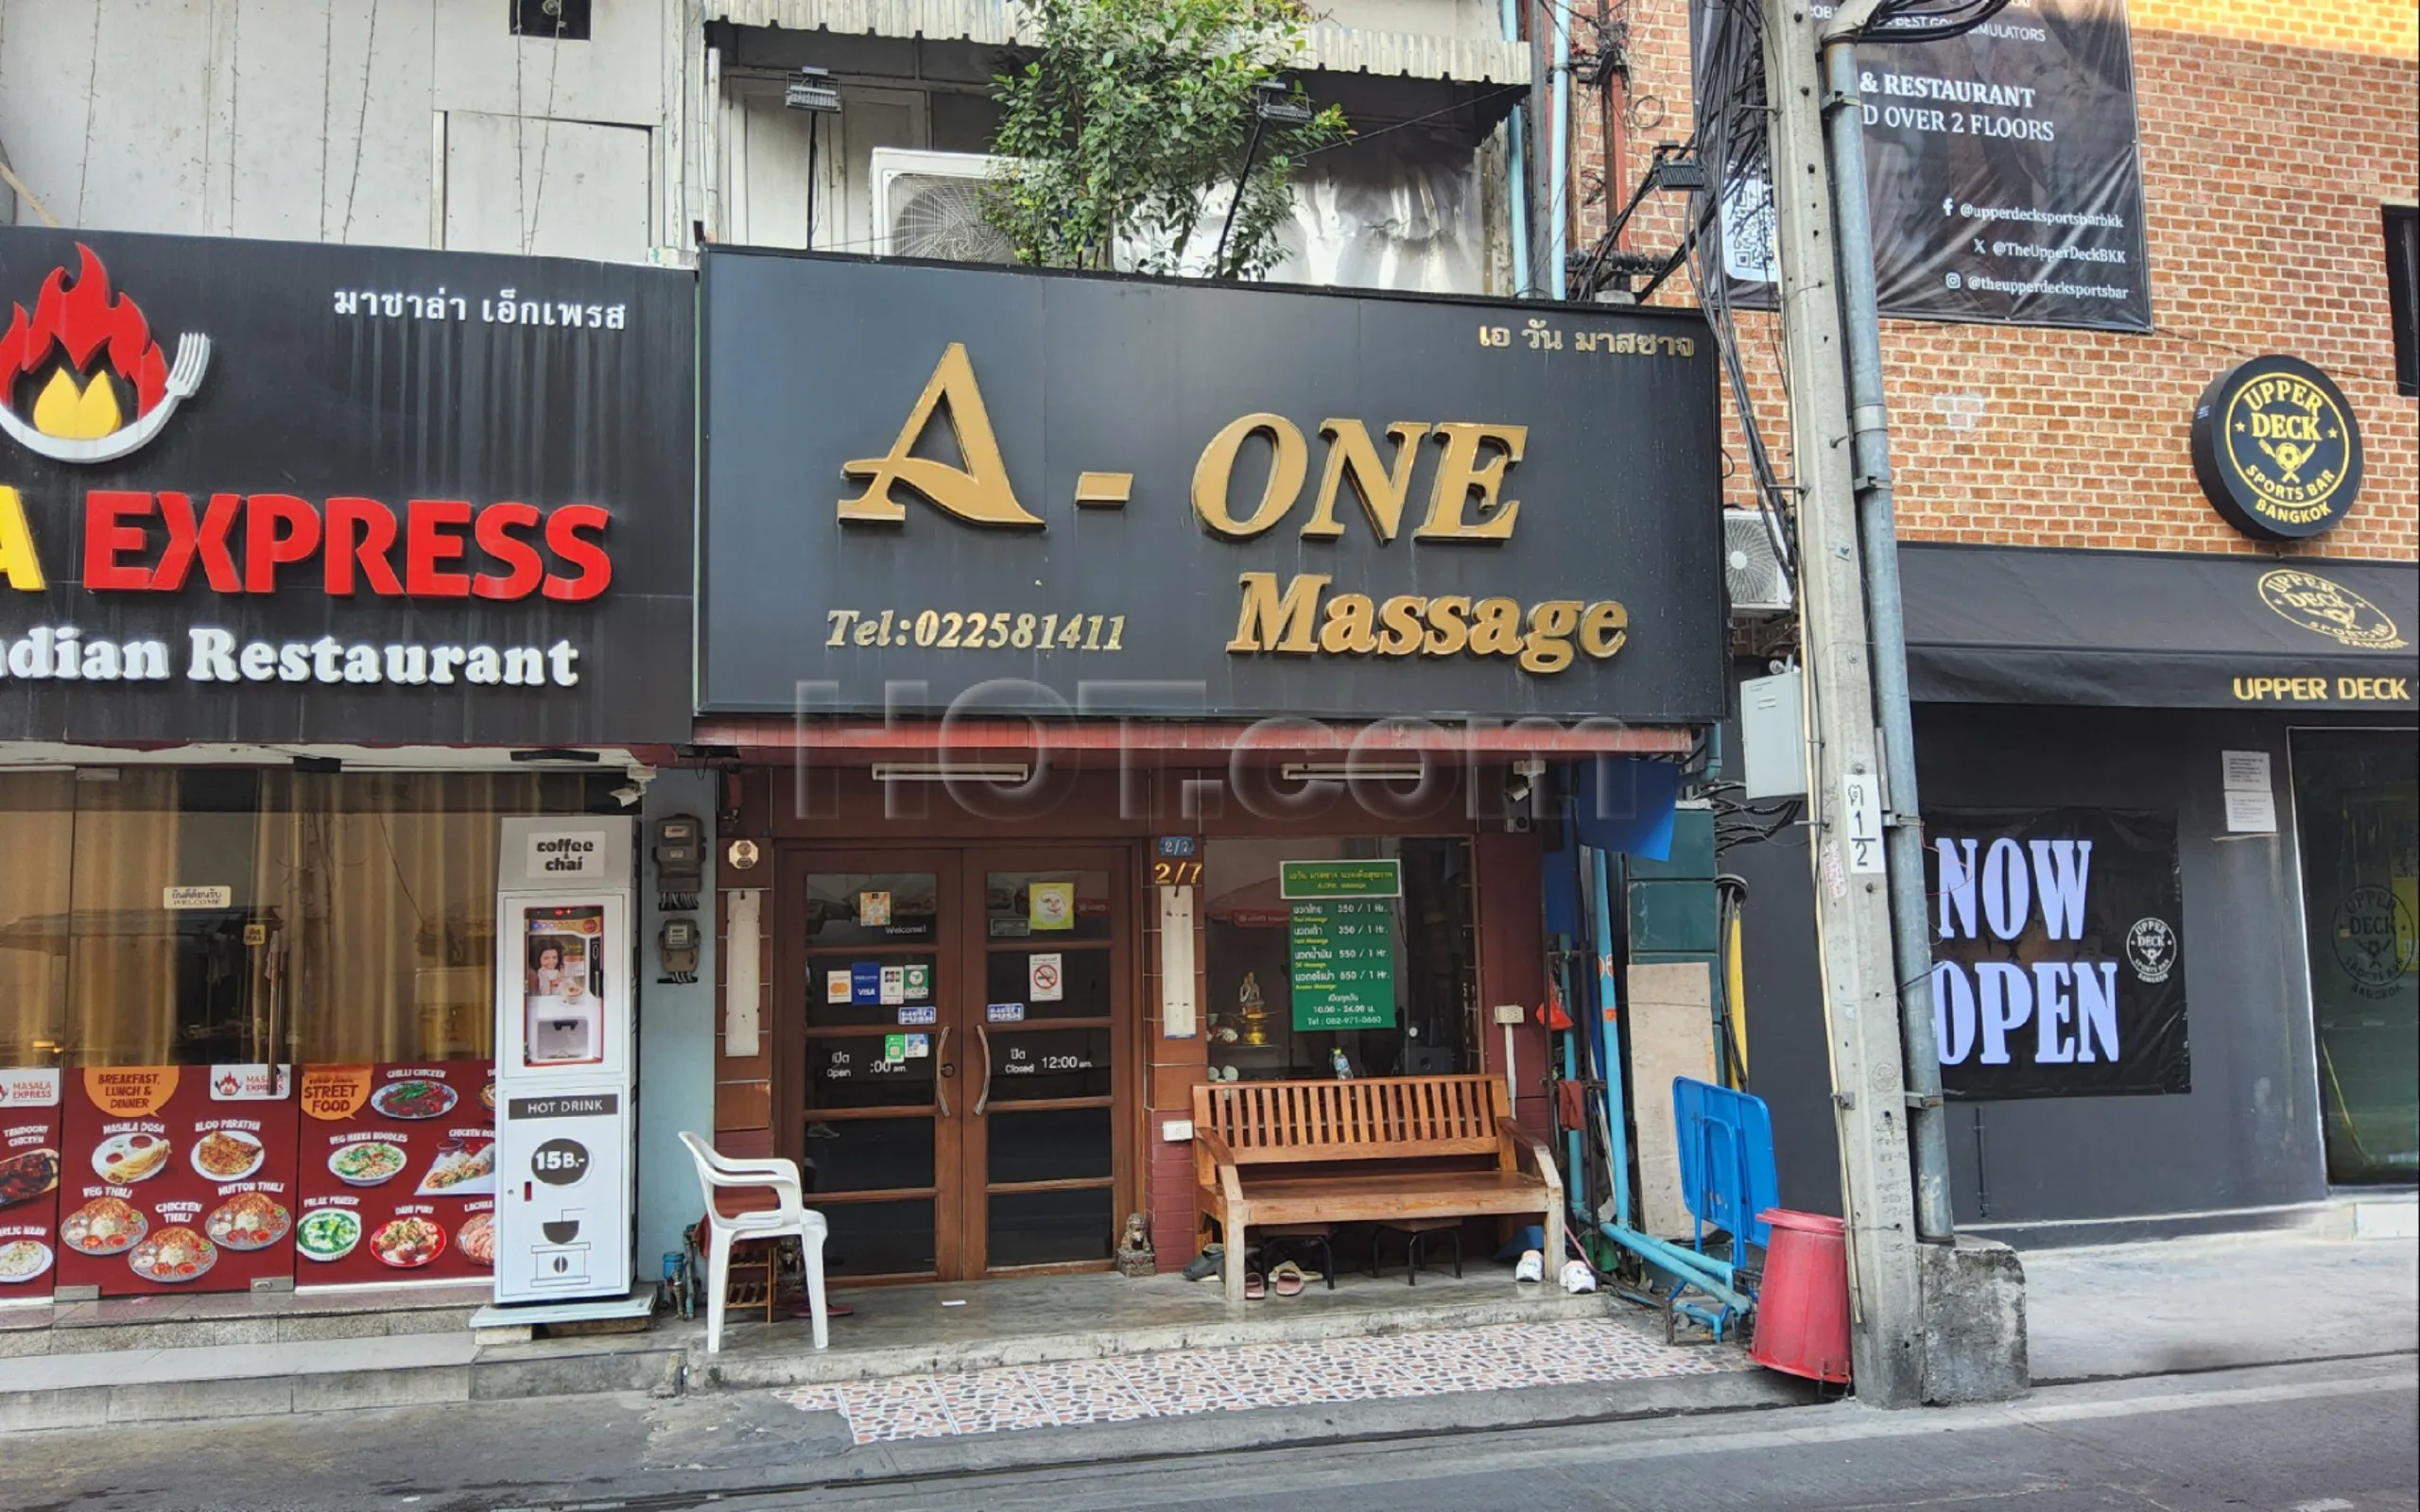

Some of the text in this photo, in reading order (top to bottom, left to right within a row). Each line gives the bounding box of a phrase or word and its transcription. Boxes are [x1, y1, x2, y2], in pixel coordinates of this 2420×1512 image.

[1859, 72, 2035, 108] & RESTAURANT
[1862, 105, 2054, 141] D OVER 2 FLOORS
[1961, 203, 2124, 228] @upperdecksportsbarbkk
[1993, 241, 2126, 264] @TheUpperDeckBKK
[1968, 275, 2129, 300] @theupperdecksportsbar
[482, 289, 626, 330] เอ็กเพรส
[1479, 318, 1695, 357] เอ วัน มาสซาจ
[2243, 380, 2323, 417] UPPER
[2251, 412, 2323, 441] DECK
[837, 341, 1046, 527] A
[1191, 412, 1529, 544] ONE
[2246, 464, 2335, 500] SPORTS BAR
[2256, 499, 2332, 524] BANGKOK
[83, 490, 612, 602] EXPRESS
[2265, 573, 2339, 597] UPPER
[2282, 592, 2355, 610] DECK
[826, 610, 1126, 650] Tel:022581411
[1225, 571, 1629, 675] Massage
[188, 629, 579, 686] Restaurant
[2233, 677, 2411, 701] UPPER DECK
[1855, 810, 1862, 835] 1
[537, 838, 594, 851] coffee
[1856, 840, 1868, 866] 2
[545, 856, 583, 871] chai
[1154, 861, 1202, 885] 2/7
[1935, 837, 2092, 940] NOW
[2343, 890, 2397, 915] UPPER
[885, 925, 926, 935] Welcome!
[2135, 920, 2167, 937] UPPER
[2350, 916, 2396, 935] DECK
[2137, 936, 2165, 947] DECK
[1932, 961, 2119, 1065] OPEN
[827, 1069, 851, 1079] Open
[1005, 1064, 1034, 1074] Closed
[1041, 1056, 1078, 1069] 12:00
[246, 1074, 284, 1083] MASA
[246, 1084, 284, 1092] EXPRS
[105, 1086, 152, 1097] LUNCH &
[110, 1097, 149, 1108] DINNER
[303, 1085, 359, 1099] STREET
[312, 1099, 350, 1113] FOOD
[527, 1100, 603, 1114] HOT DRINK
[155, 1202, 203, 1213] CHICKEN
